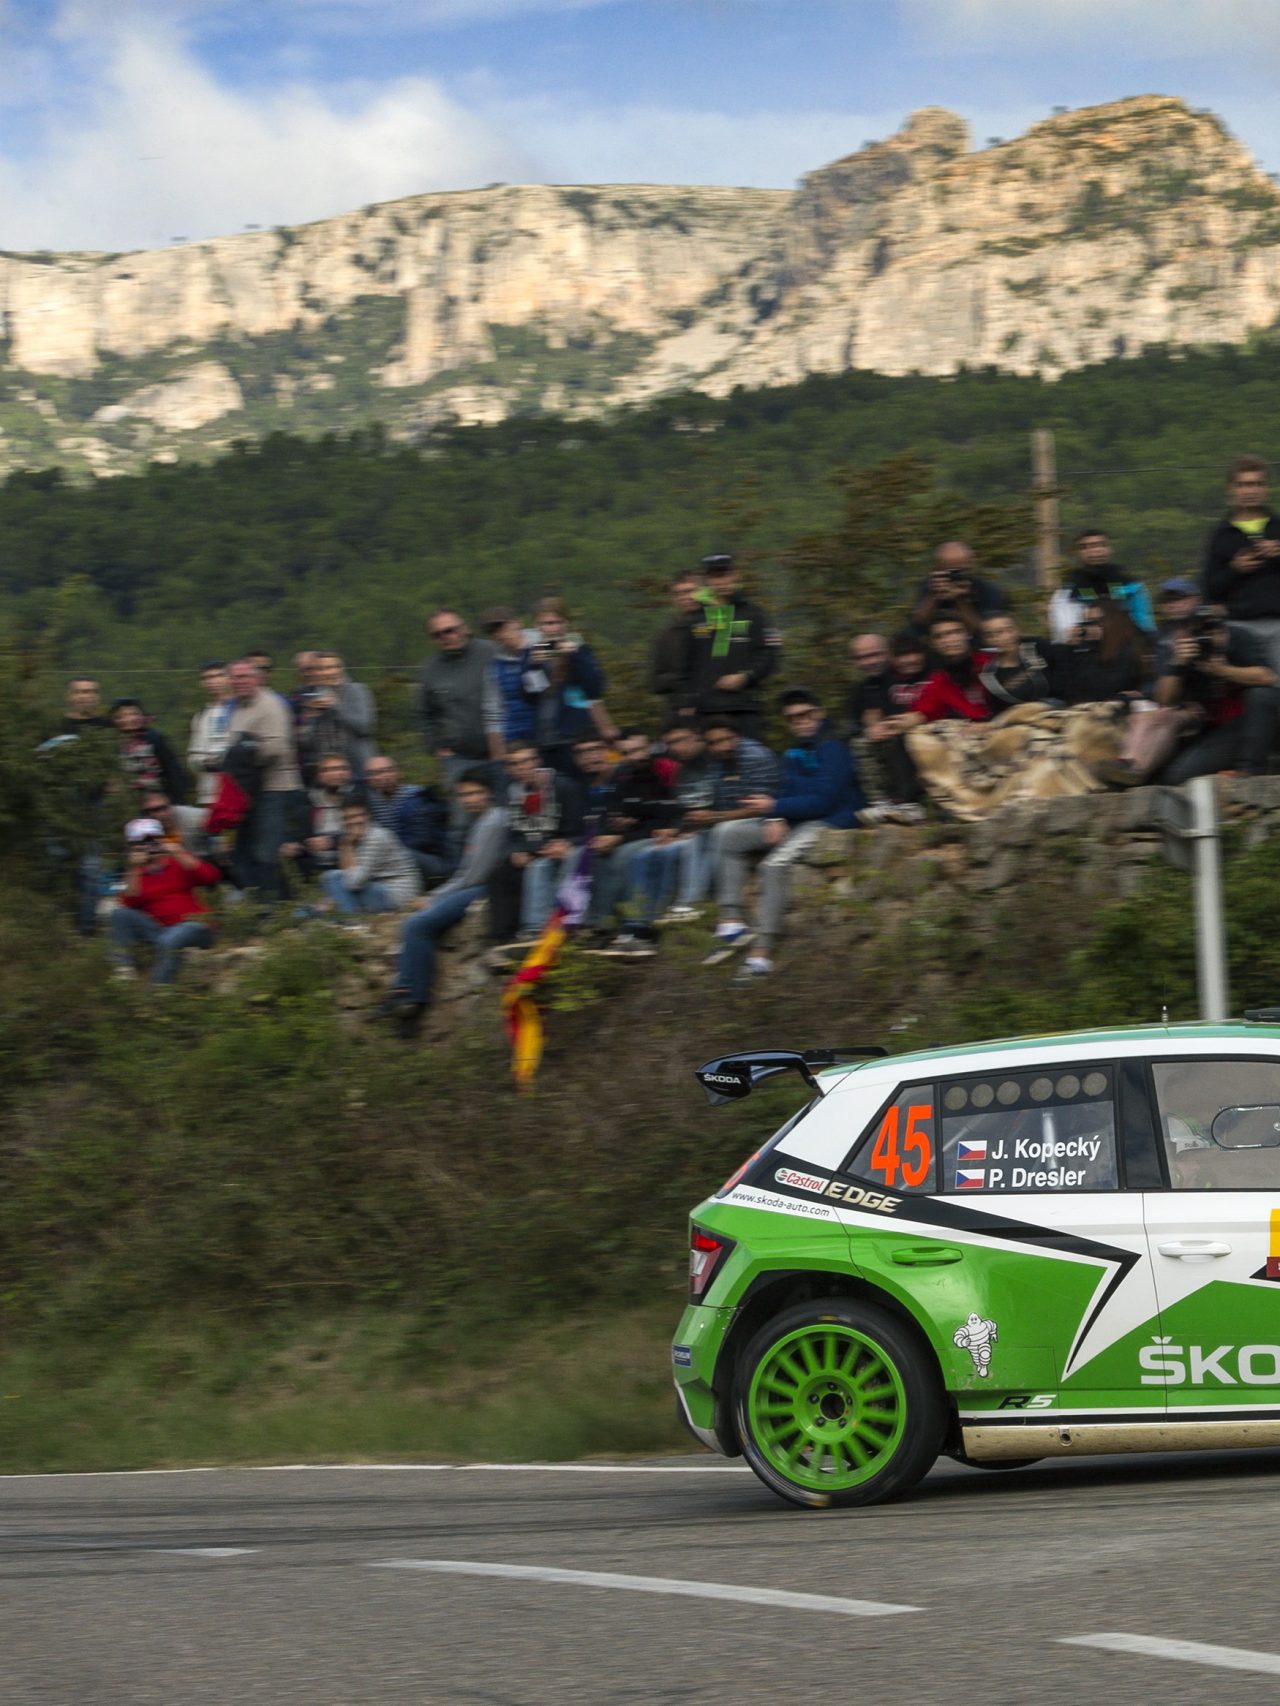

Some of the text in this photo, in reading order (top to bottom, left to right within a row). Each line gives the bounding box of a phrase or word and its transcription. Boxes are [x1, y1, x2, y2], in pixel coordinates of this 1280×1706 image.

[870, 1104, 933, 1187] 45
[991, 1135, 1101, 1162] J. Kopecký
[989, 1166, 1086, 1188] P. Dresler
[731, 1191, 830, 1217] www.skoda-auto.com
[786, 1171, 824, 1192] Castrol
[823, 1181, 903, 1214] EDGE
[997, 1394, 1057, 1410] R5
